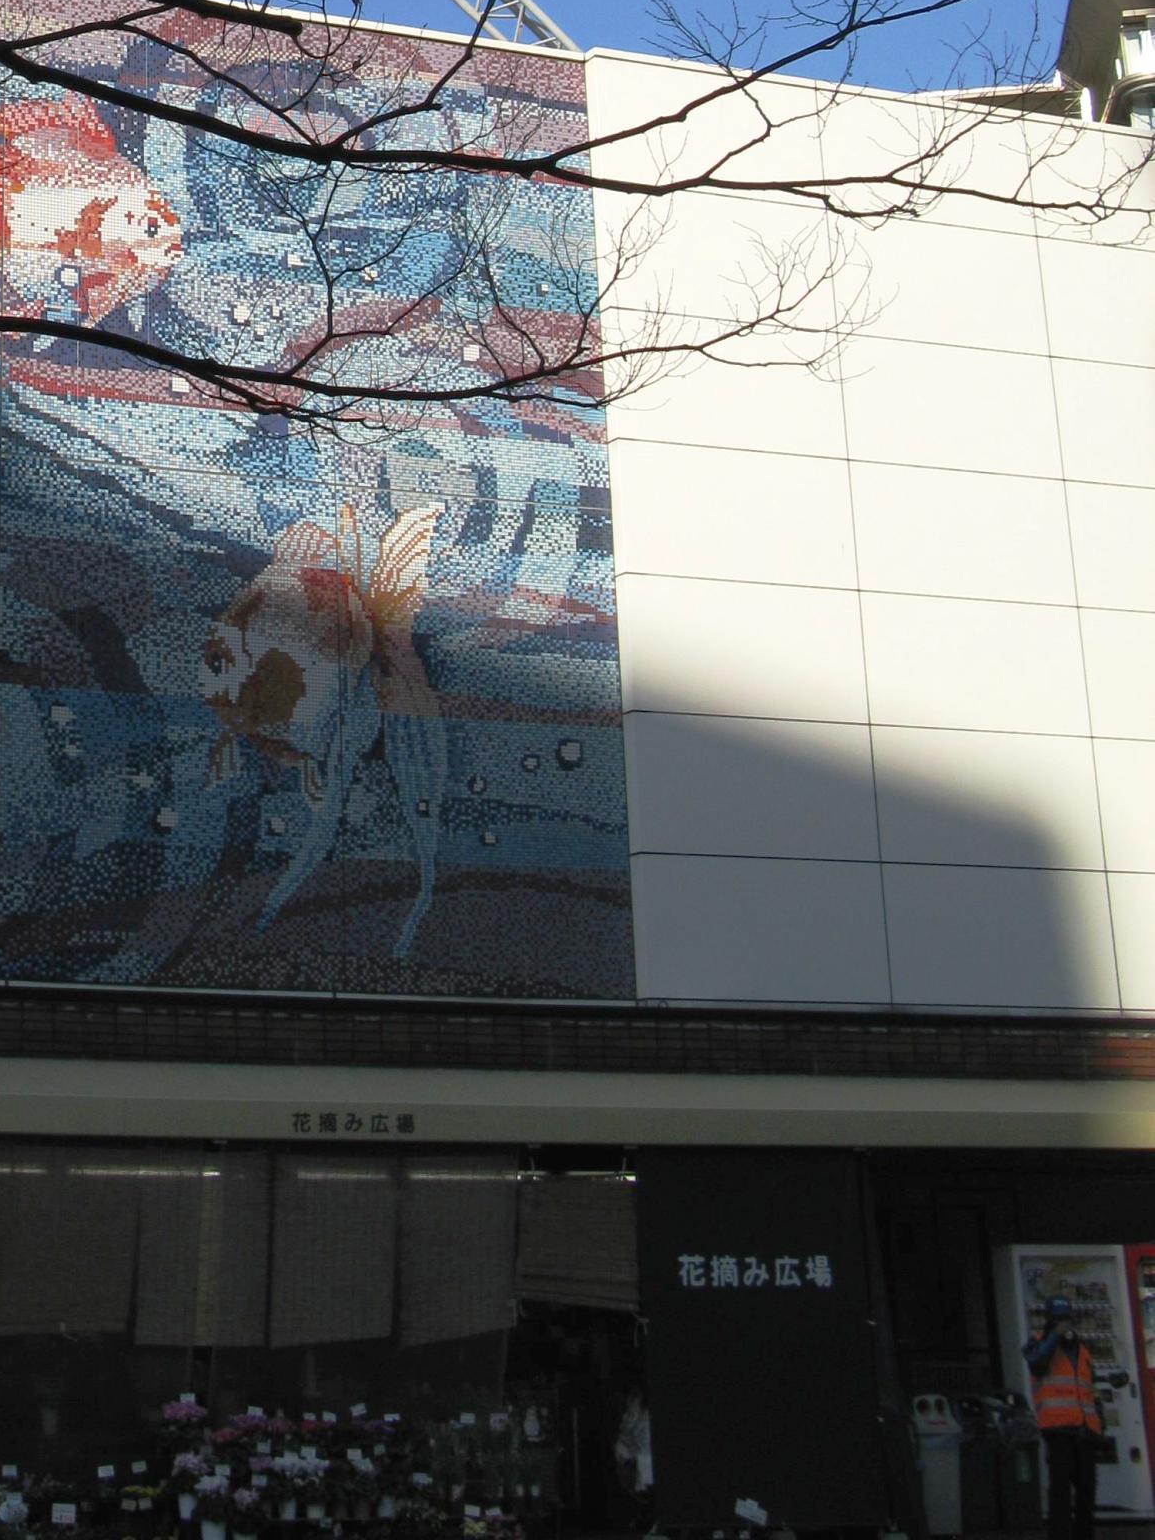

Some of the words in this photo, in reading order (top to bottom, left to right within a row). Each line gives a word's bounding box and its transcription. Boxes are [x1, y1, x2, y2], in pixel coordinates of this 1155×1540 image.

[292, 1111, 415, 1133] 花摘み広場
[677, 1254, 833, 1287] 花摘み広場
